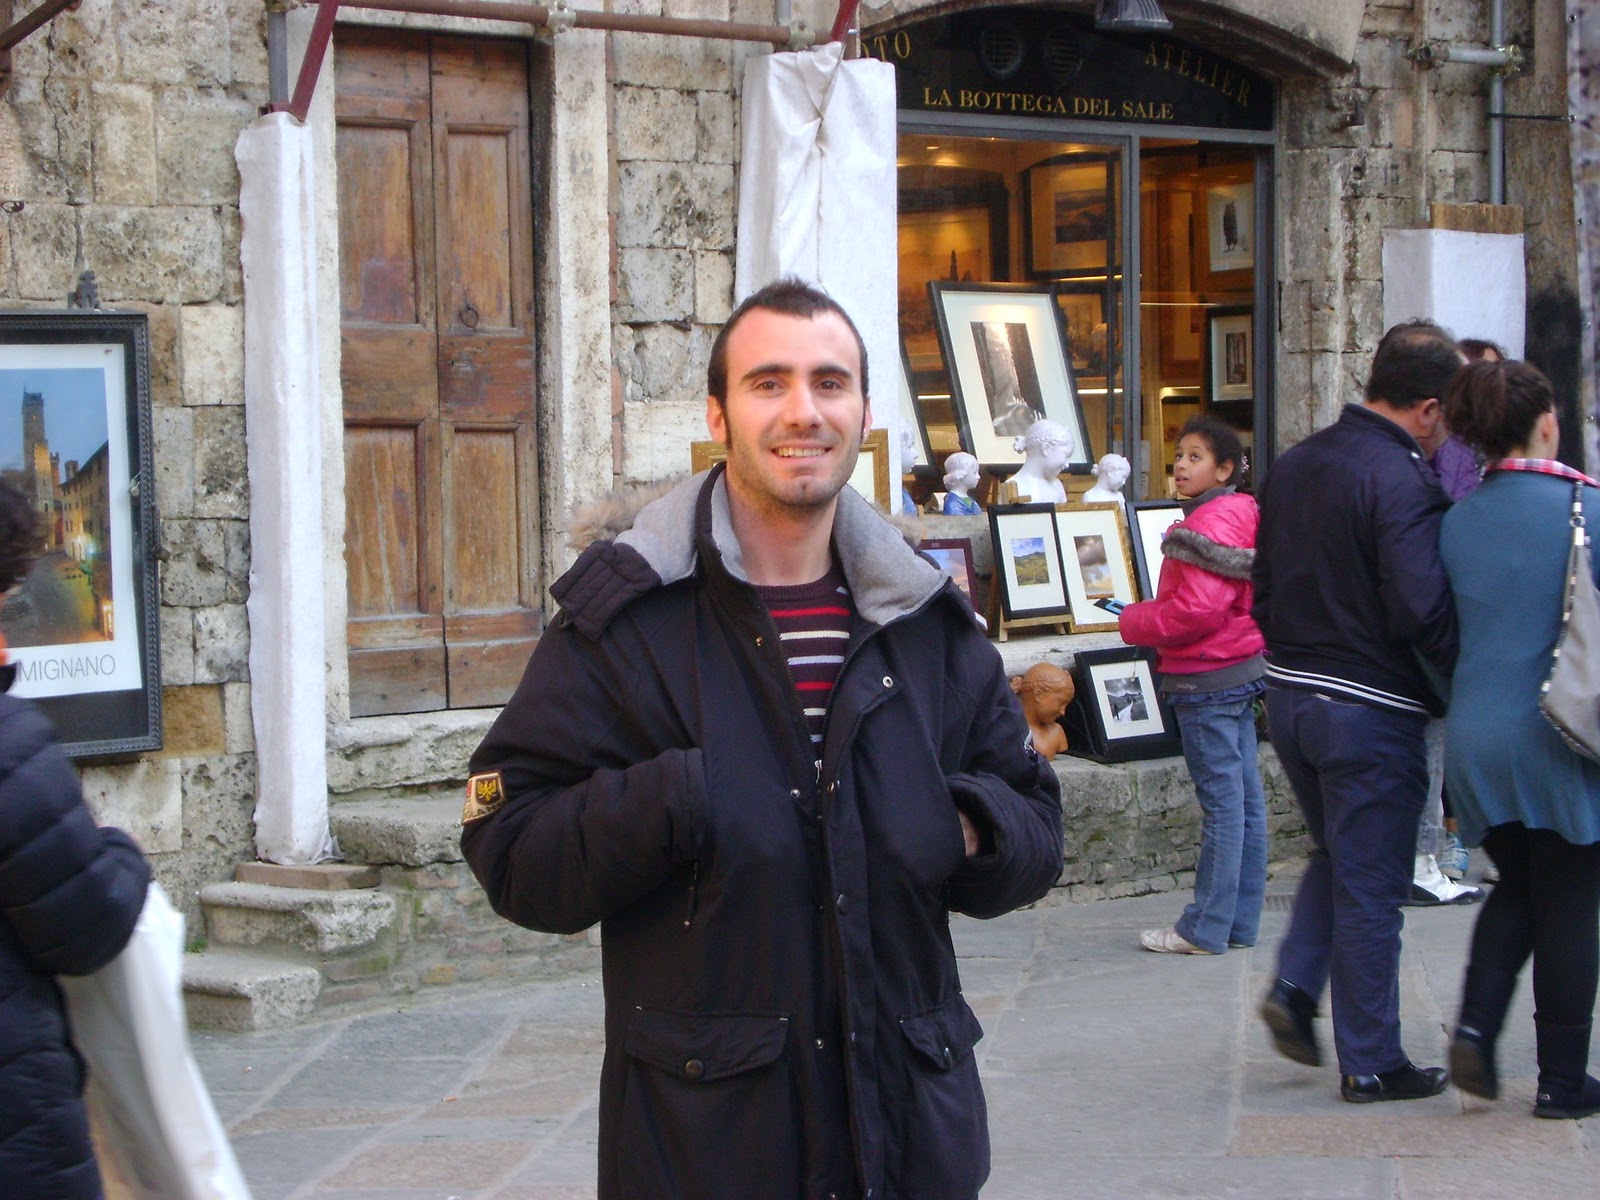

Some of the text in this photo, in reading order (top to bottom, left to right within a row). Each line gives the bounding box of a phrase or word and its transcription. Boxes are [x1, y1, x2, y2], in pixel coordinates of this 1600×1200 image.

[1145, 40, 1251, 107] ATELIER
[923, 87, 1174, 120] LA BOTTEGA DEL SALE
